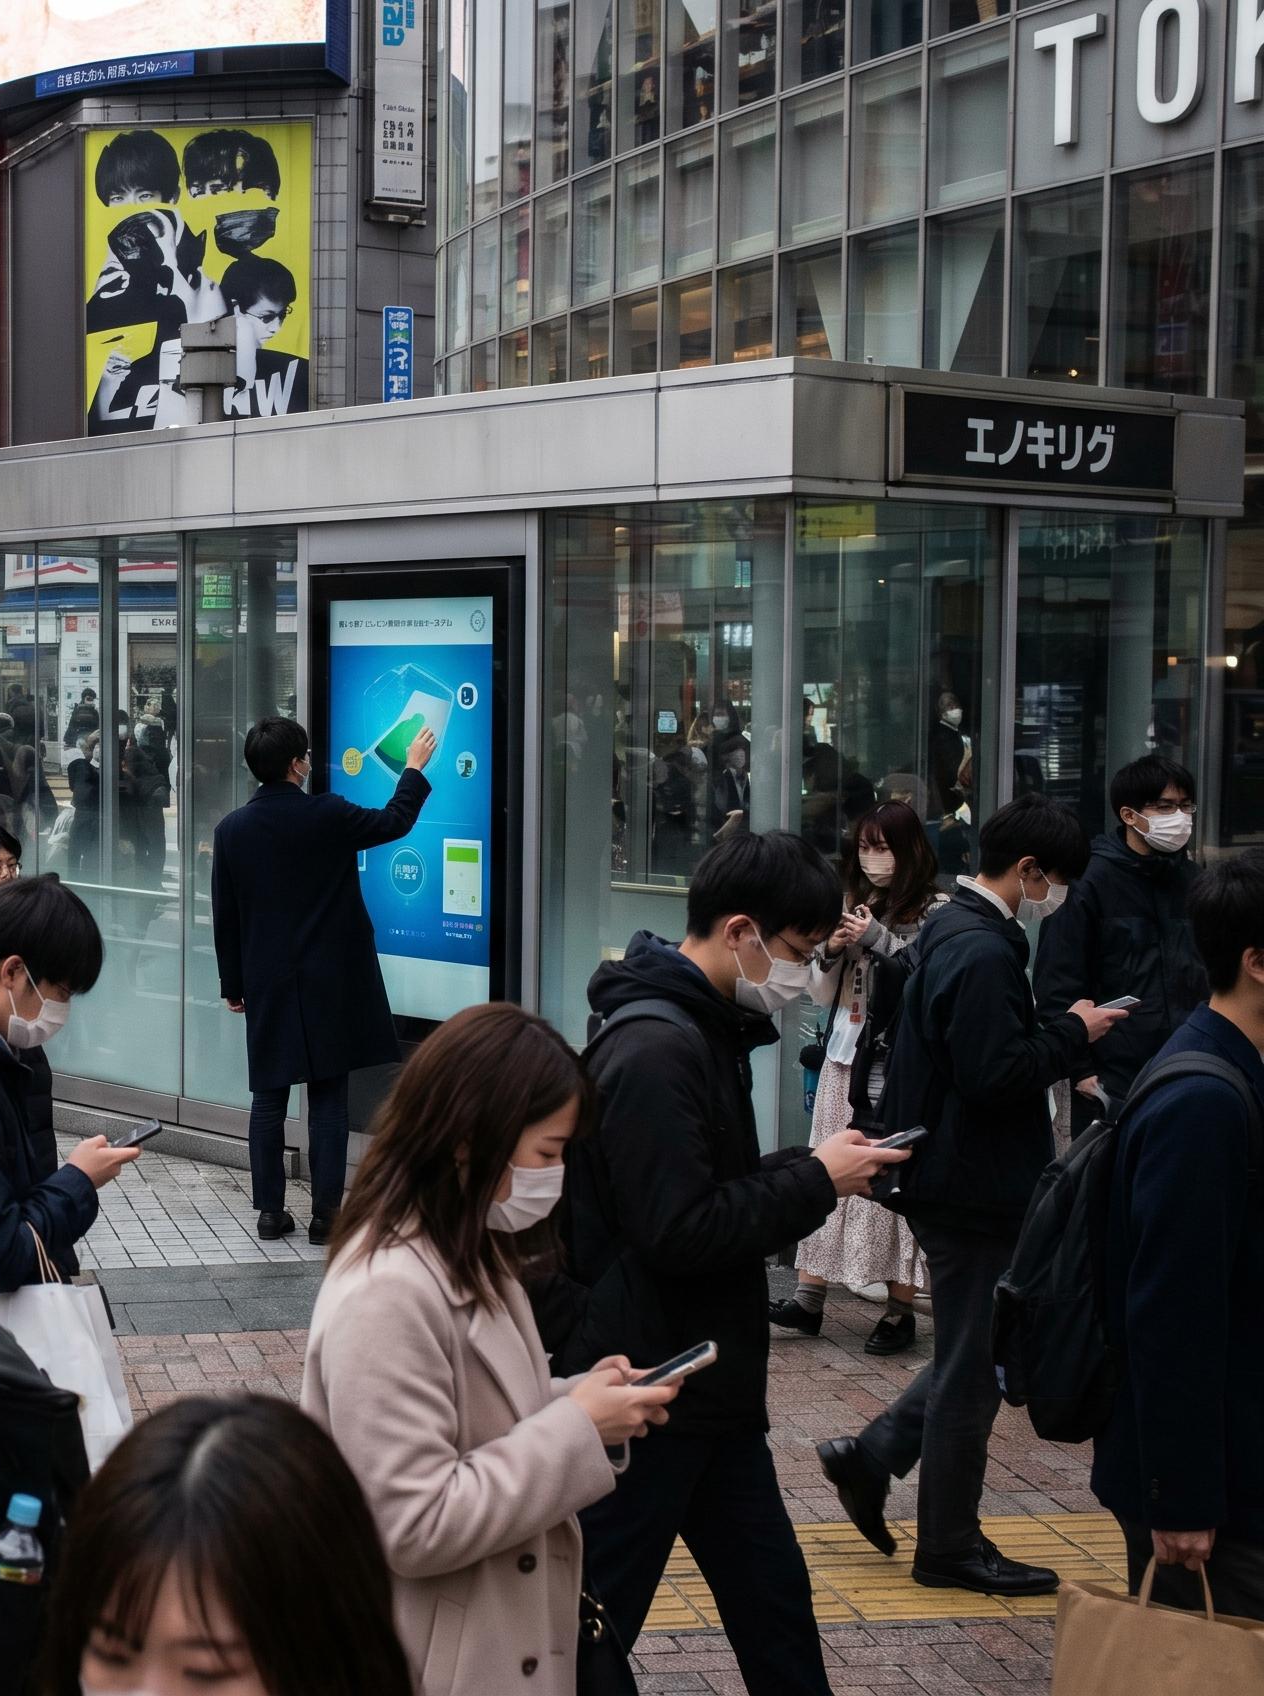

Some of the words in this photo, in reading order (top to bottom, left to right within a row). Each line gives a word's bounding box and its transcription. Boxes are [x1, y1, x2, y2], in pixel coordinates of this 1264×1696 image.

[965, 418, 1116, 474] エノキリグ
